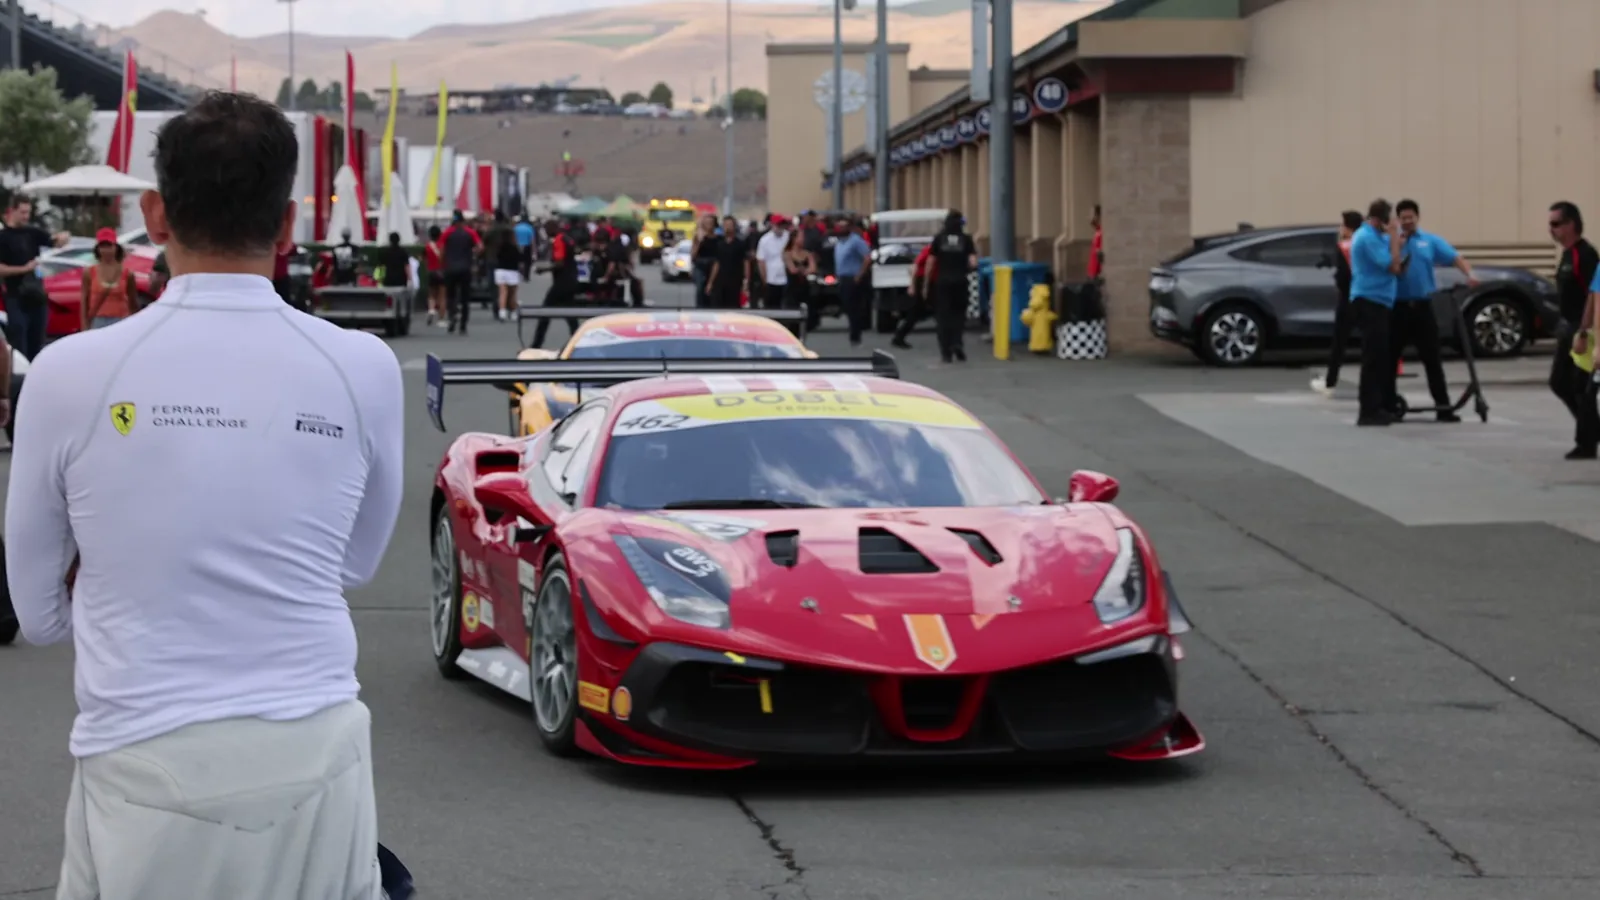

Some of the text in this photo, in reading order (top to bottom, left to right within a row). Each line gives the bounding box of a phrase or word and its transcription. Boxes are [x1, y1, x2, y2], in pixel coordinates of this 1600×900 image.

[714, 392, 898, 408] DOBEL
[151, 405, 220, 416] FERRARI
[152, 417, 249, 429] CHALLENGE
[296, 419, 344, 440] PIRELLI
[618, 414, 691, 430] 462
[672, 546, 718, 573] aws
